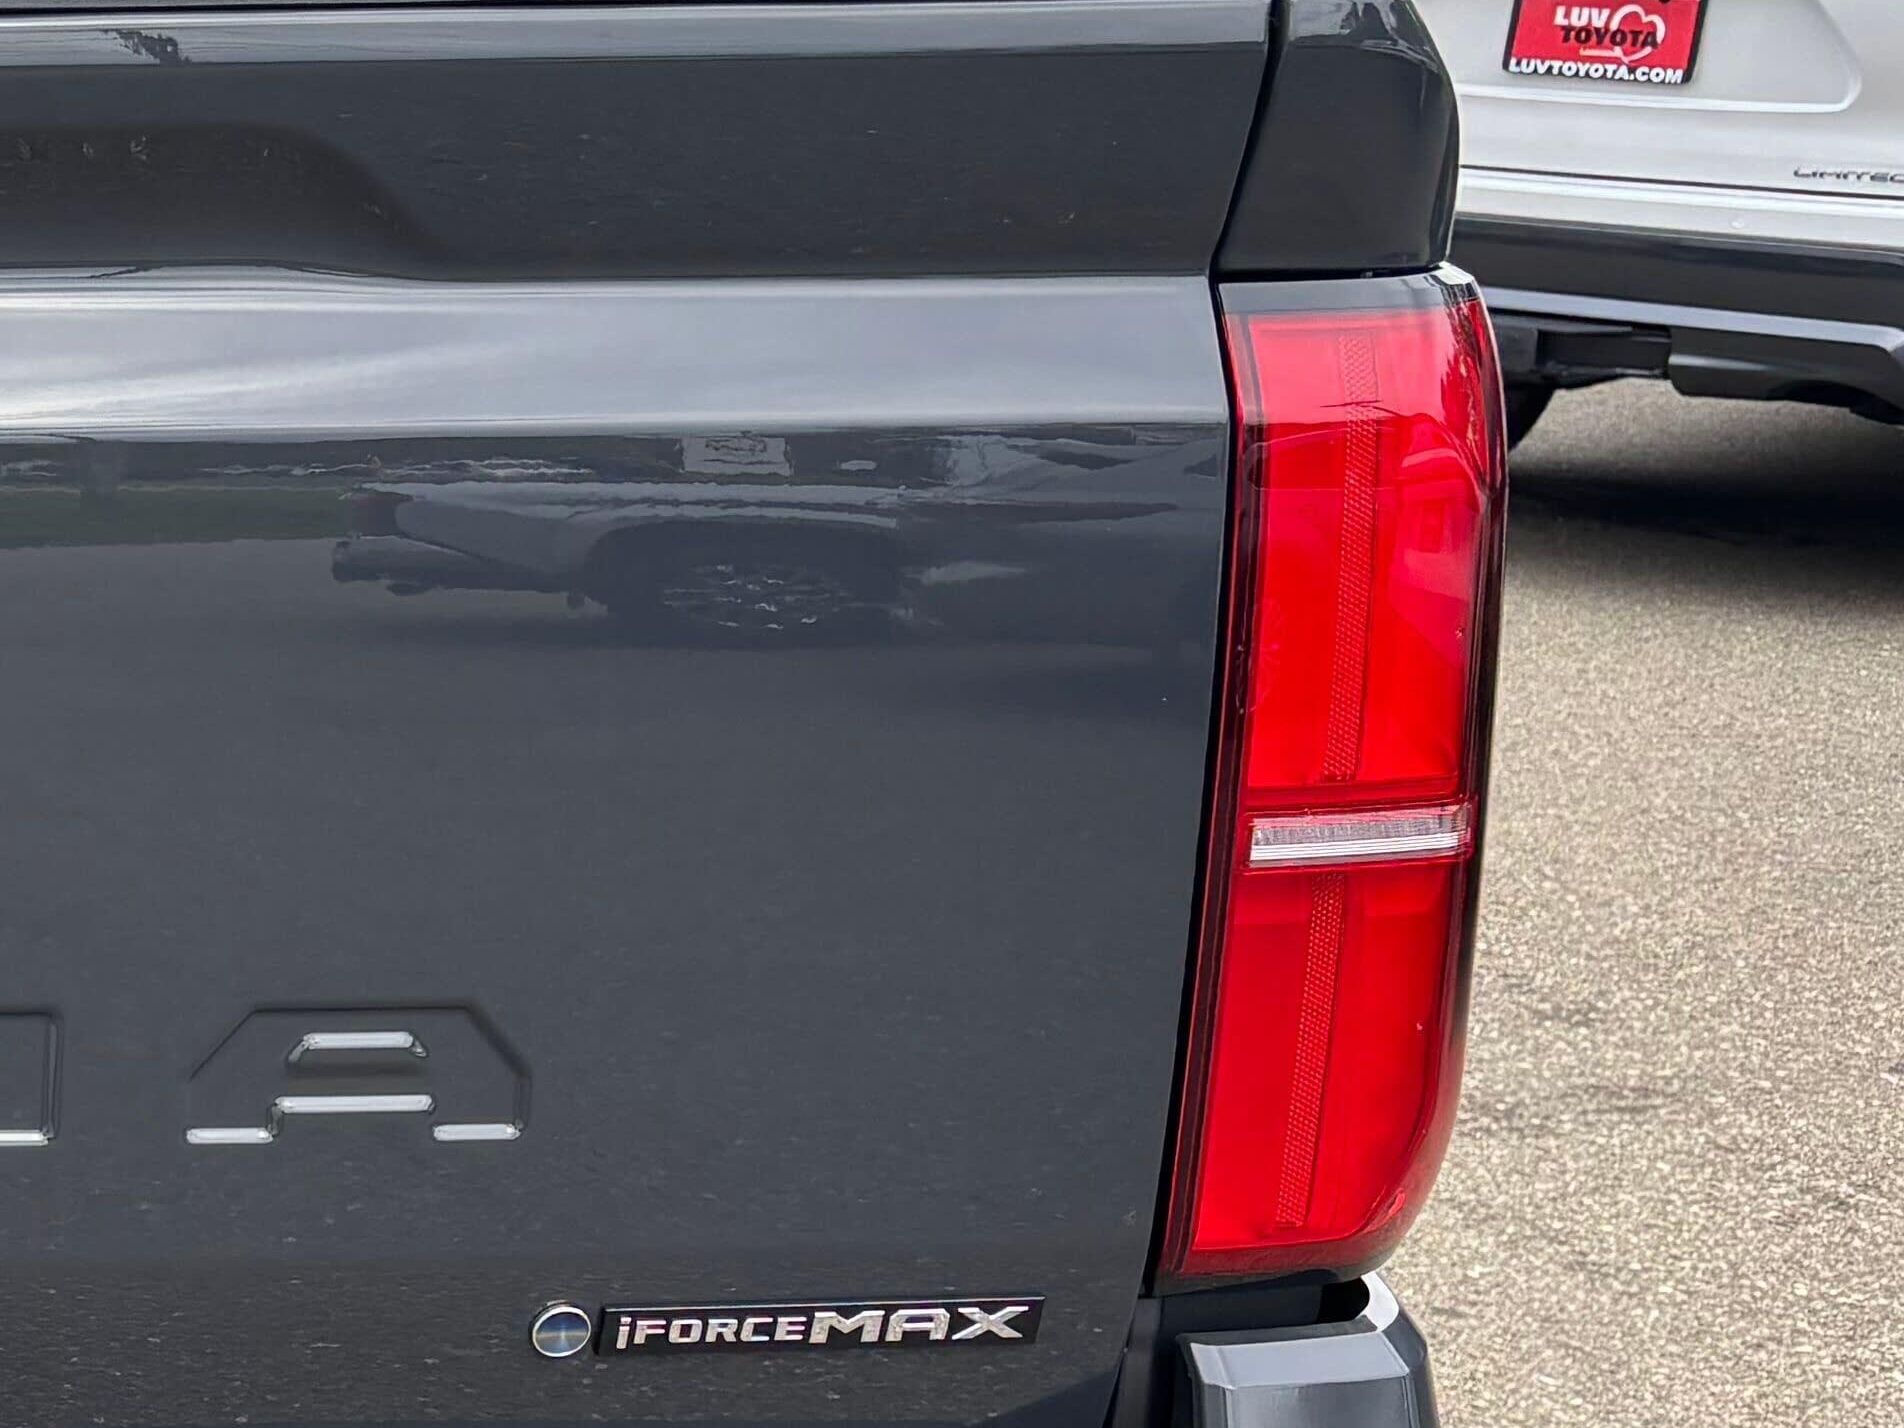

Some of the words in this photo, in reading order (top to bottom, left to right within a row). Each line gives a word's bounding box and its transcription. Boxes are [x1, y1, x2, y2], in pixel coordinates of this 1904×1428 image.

[1554, 5, 1612, 28] LUV
[1561, 26, 1660, 50] TOYOTA
[1508, 57, 1685, 85] LUVTOYOTA.COM
